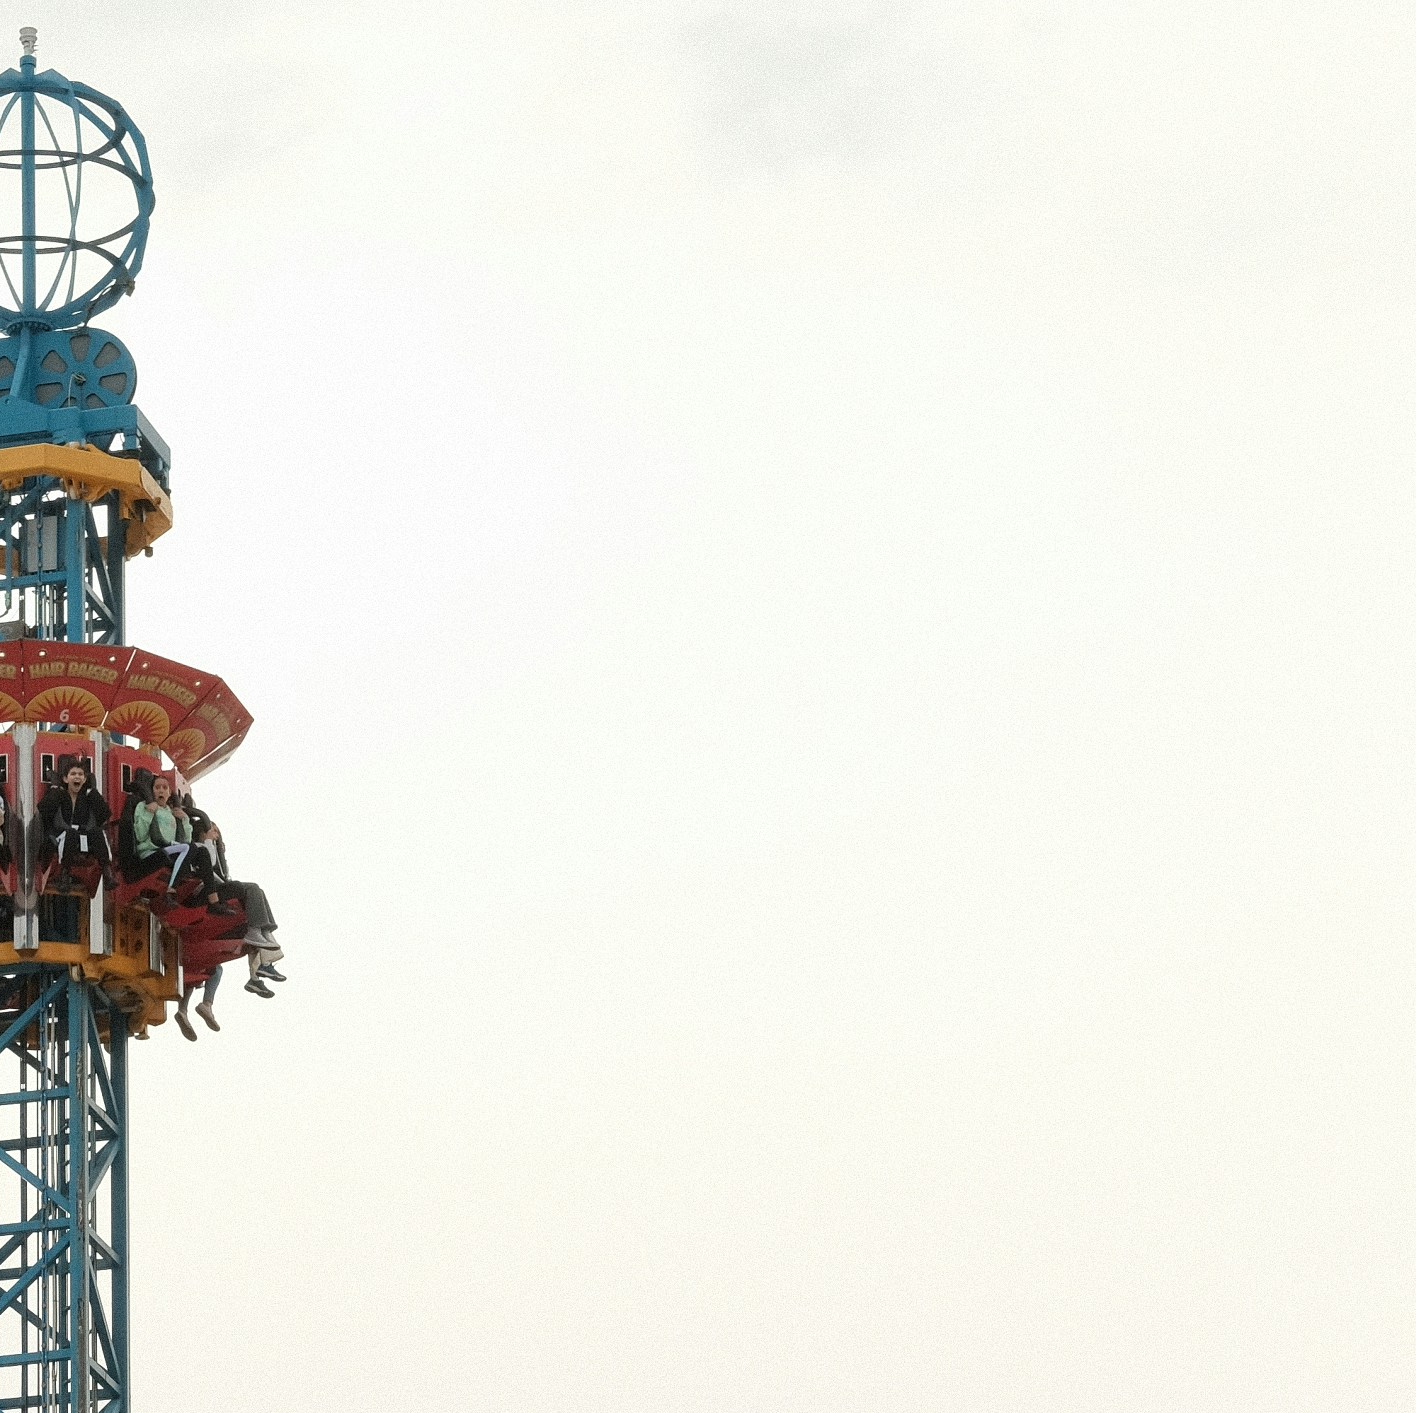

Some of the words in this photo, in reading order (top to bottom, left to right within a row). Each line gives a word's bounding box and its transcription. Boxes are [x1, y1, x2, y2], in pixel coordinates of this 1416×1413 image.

[29, 661, 65, 680] HAIR
[67, 661, 118, 684] RAISER
[59, 708, 70, 722] 6
[130, 723, 142, 735] 7
